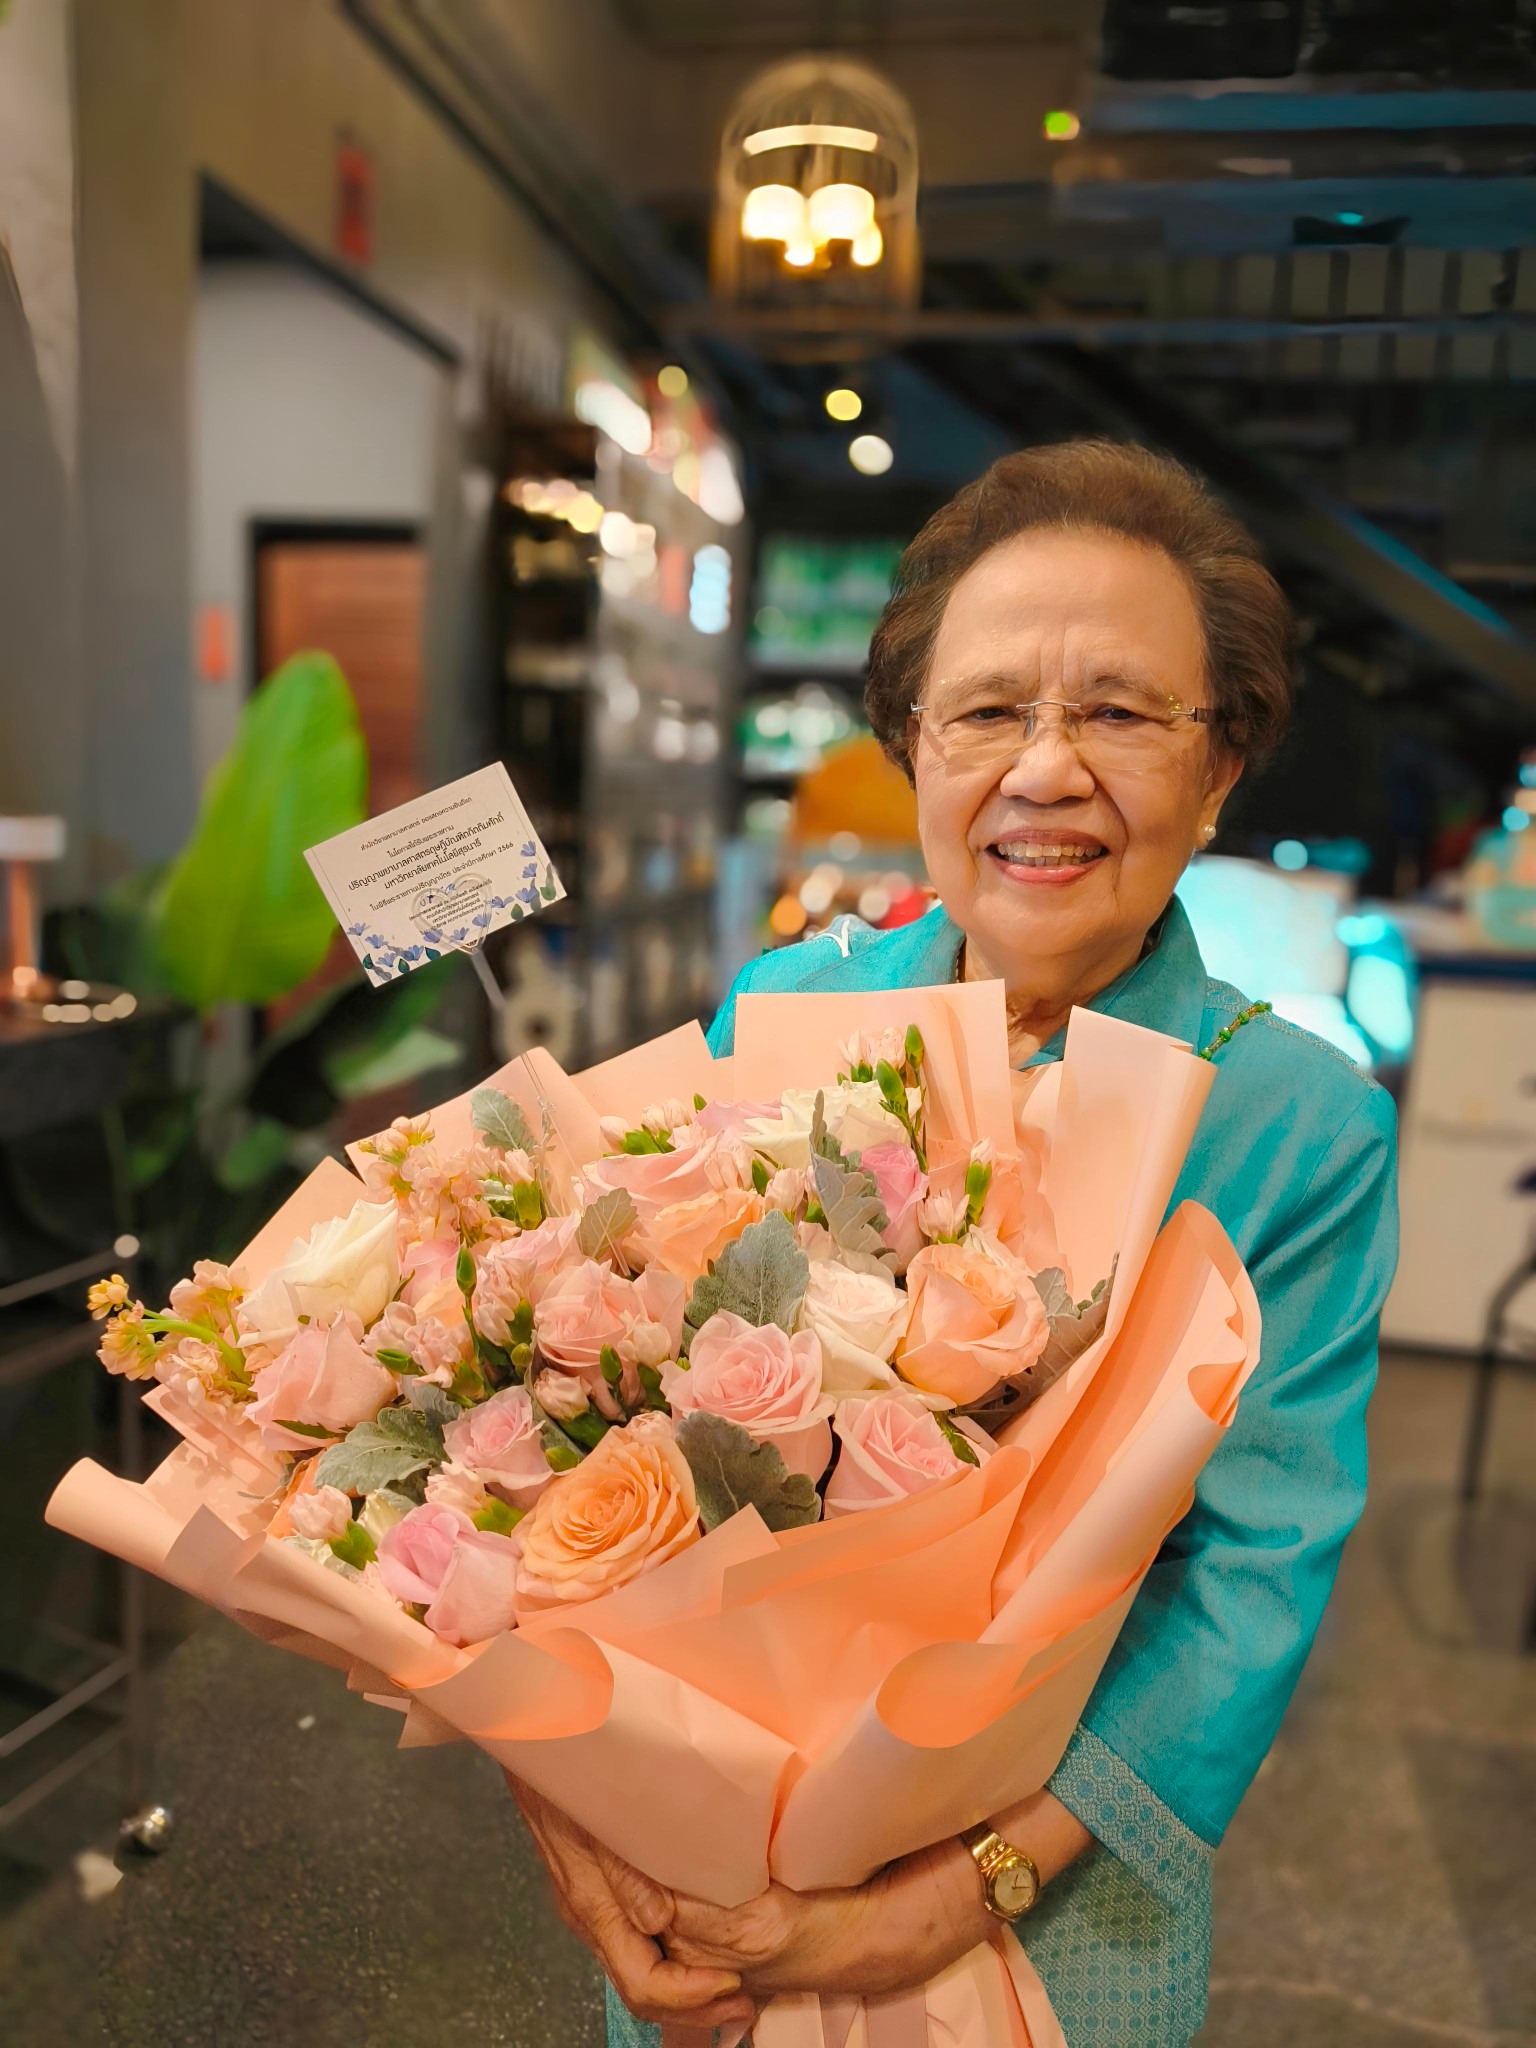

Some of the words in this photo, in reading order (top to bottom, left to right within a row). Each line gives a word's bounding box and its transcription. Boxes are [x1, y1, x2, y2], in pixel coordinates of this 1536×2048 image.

[497, 841, 513, 852] 2566
[383, 837, 481, 889] มหาวิทยาลัยเทคโนโลยีสุรนารี
